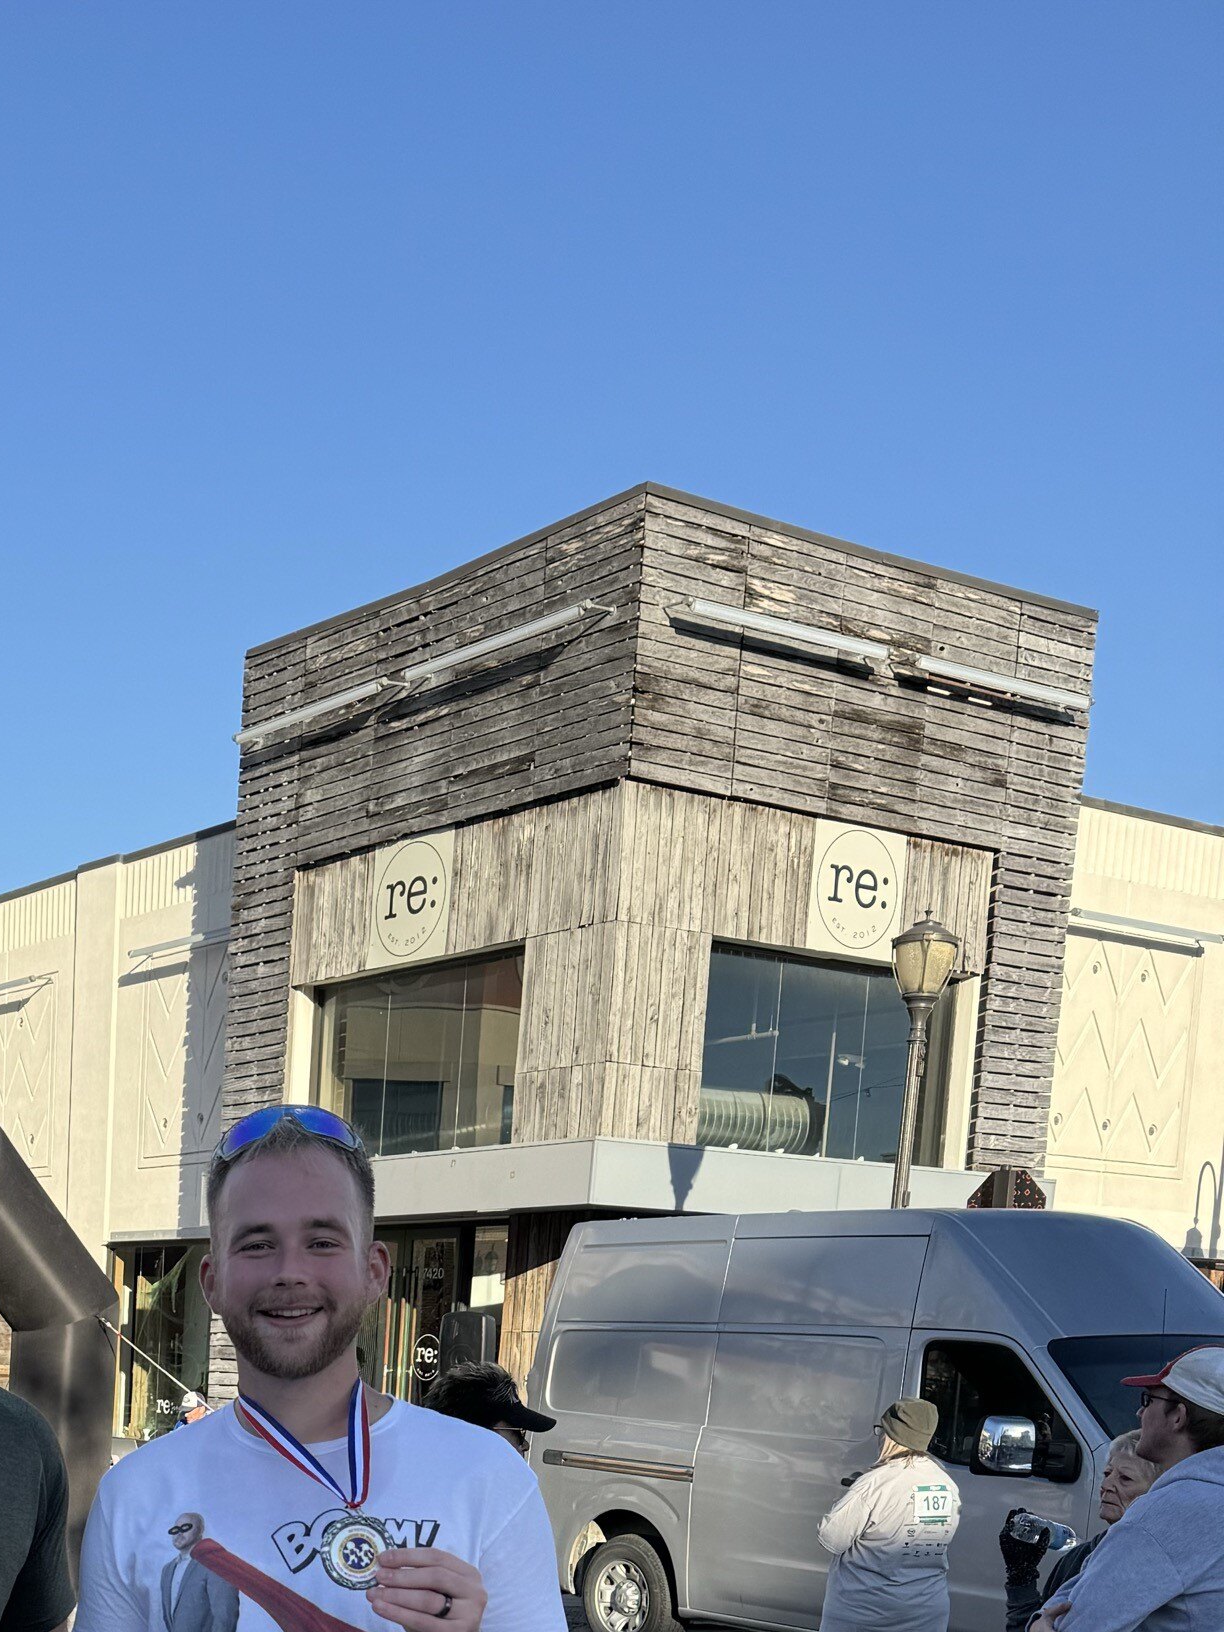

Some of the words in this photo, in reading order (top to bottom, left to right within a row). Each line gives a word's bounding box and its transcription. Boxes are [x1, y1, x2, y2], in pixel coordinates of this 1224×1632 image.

[827, 863, 889, 910] re:
[384, 875, 438, 920] re:
[404, 926, 427, 947] 2012
[853, 925, 877, 939] 2012
[415, 1346, 439, 1364] re:
[156, 1398, 174, 1415] re:
[923, 1495, 948, 1511] 187
[271, 1508, 441, 1574] BM!
